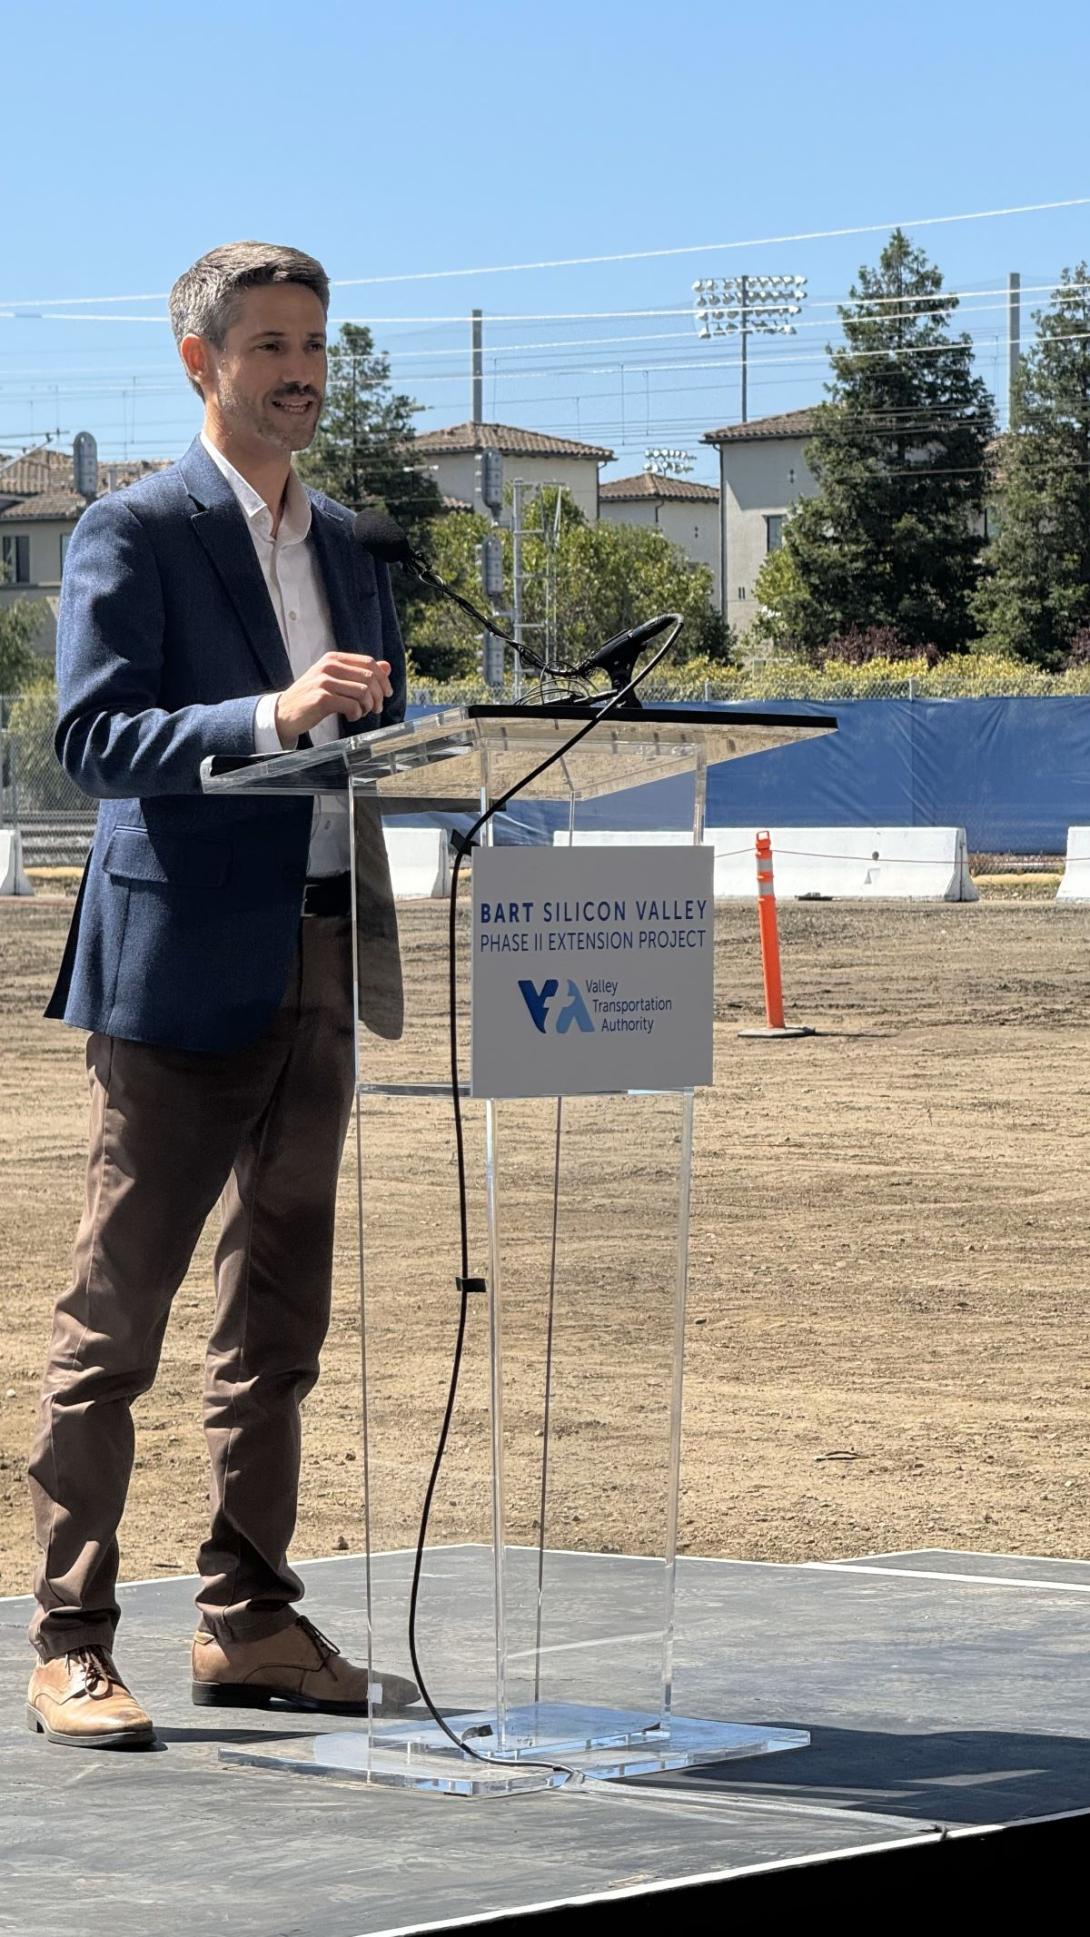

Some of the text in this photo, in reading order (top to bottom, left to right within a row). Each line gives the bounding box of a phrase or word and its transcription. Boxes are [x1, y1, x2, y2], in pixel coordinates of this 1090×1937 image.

[480, 900, 707, 923] BART SILICON VALLEY
[480, 929, 706, 952] PHASE II EXTENSION PROJECT
[585, 979, 618, 996] Valley
[593, 996, 672, 1013] Transportation
[601, 1016, 654, 1034] Authority
